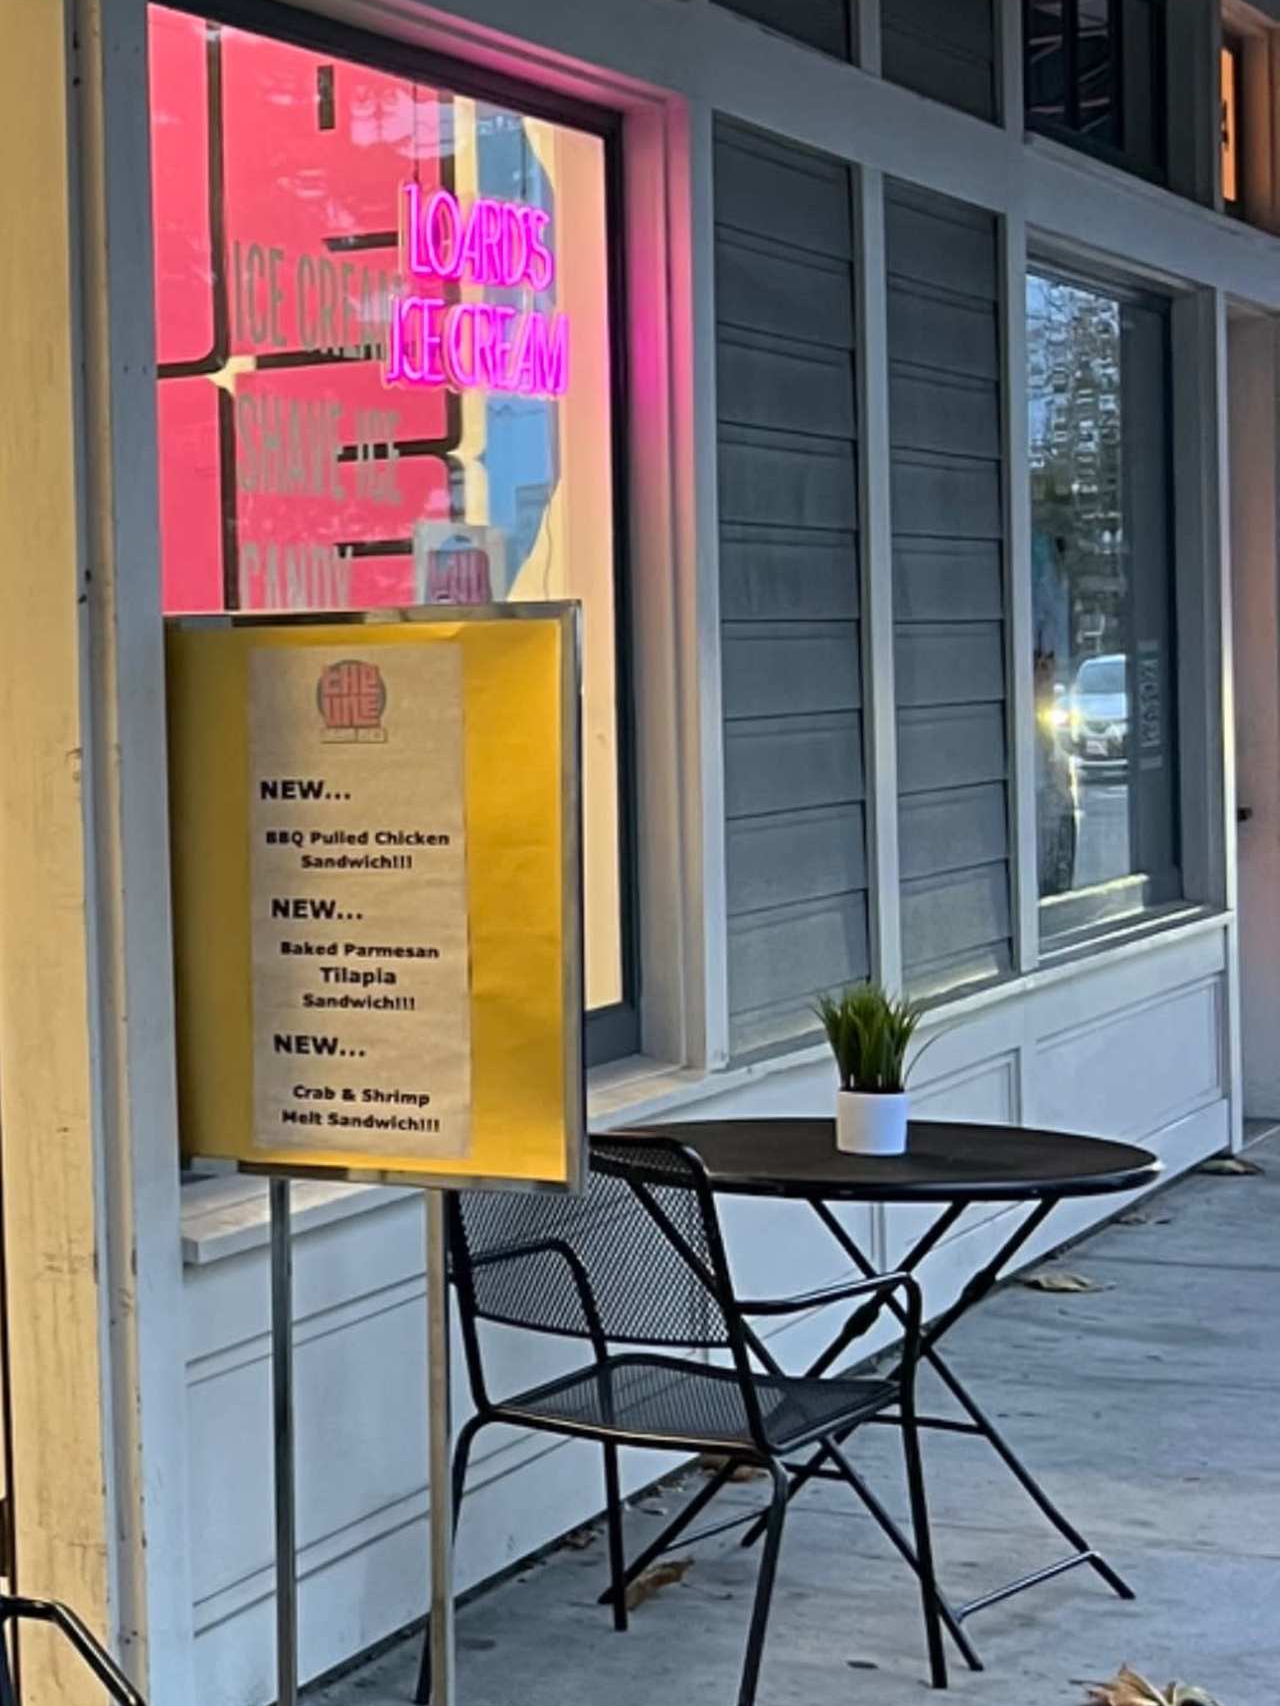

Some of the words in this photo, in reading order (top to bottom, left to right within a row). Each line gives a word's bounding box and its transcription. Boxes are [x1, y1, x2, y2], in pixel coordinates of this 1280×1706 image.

[233, 239, 287, 347] ICE
[387, 296, 445, 381] ICE
[450, 302, 569, 394] CREAM
[260, 779, 352, 802] NEW...
[265, 830, 304, 850] BBQ
[310, 830, 369, 847] Pulled
[374, 830, 450, 848] Chicken
[301, 853, 413, 871] Sandwich!!!
[270, 899, 364, 922] NEW...
[280, 941, 338, 958] Baked
[344, 943, 440, 961] Parmesan
[319, 966, 397, 991] Tilapia
[302, 993, 416, 1012] Sandwich!!!
[273, 1034, 366, 1058] NEW...
[292, 1084, 336, 1102] Crab
[341, 1086, 357, 1102] &
[362, 1086, 431, 1108] Shrimp
[281, 1109, 324, 1127] Melt
[327, 1111, 441, 1134] Sandwich!!!
